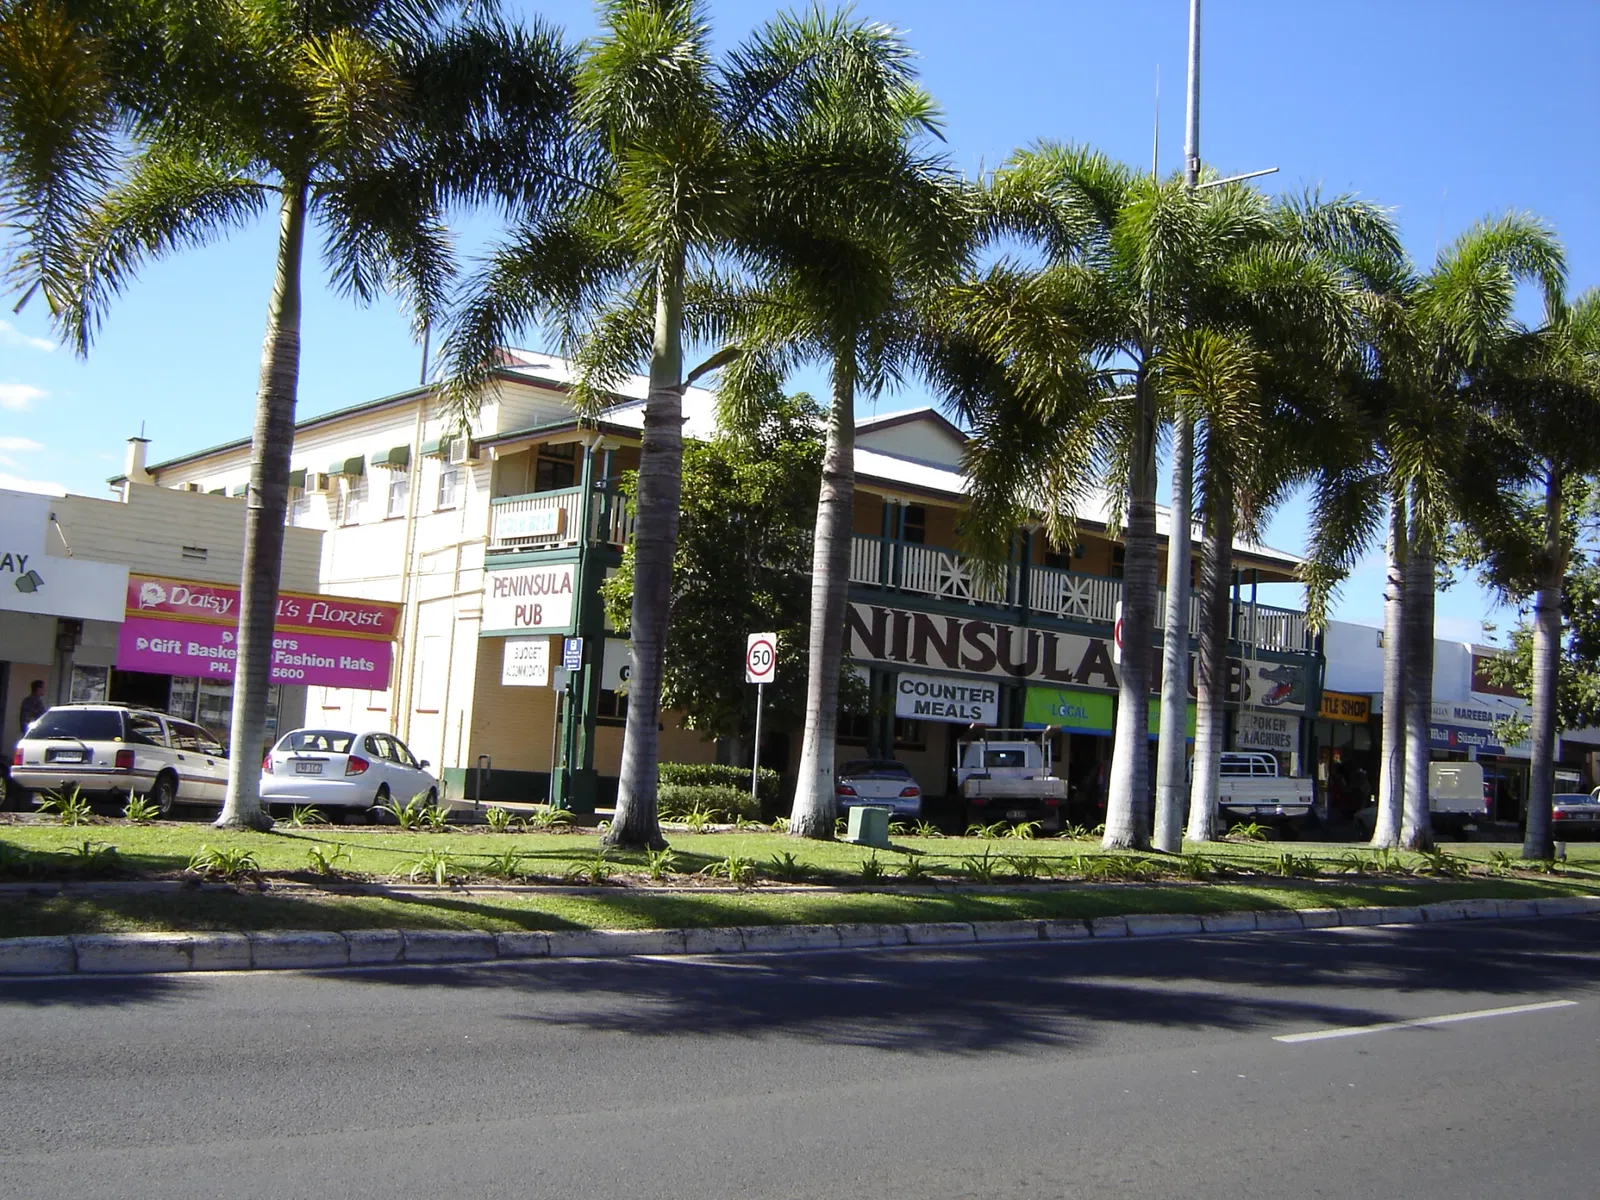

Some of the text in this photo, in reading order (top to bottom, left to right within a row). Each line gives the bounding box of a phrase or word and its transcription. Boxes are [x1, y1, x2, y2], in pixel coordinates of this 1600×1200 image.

[0, 552, 28, 574] AY
[492, 572, 572, 598] PENINSULA
[169, 586, 234, 614] Daisy
[276, 600, 301, 617] l's
[515, 604, 543, 626] PUB
[272, 638, 299, 650] ers
[843, 603, 1120, 687] NINSULA
[150, 639, 375, 671] Gift Baske Fashion Hats
[753, 650, 770, 665] 50
[210, 661, 305, 679] PH. 5600
[899, 679, 995, 704] COUNTER
[914, 700, 982, 720] MEALS
[1052, 702, 1088, 719] LOCAL
[1324, 696, 1367, 717] TLE SHOP
[1454, 707, 1493, 722] MAREEBA
[1252, 716, 1286, 732] POKER
[1243, 729, 1292, 748] MACHINES
[1457, 731, 1487, 748] Sunday
